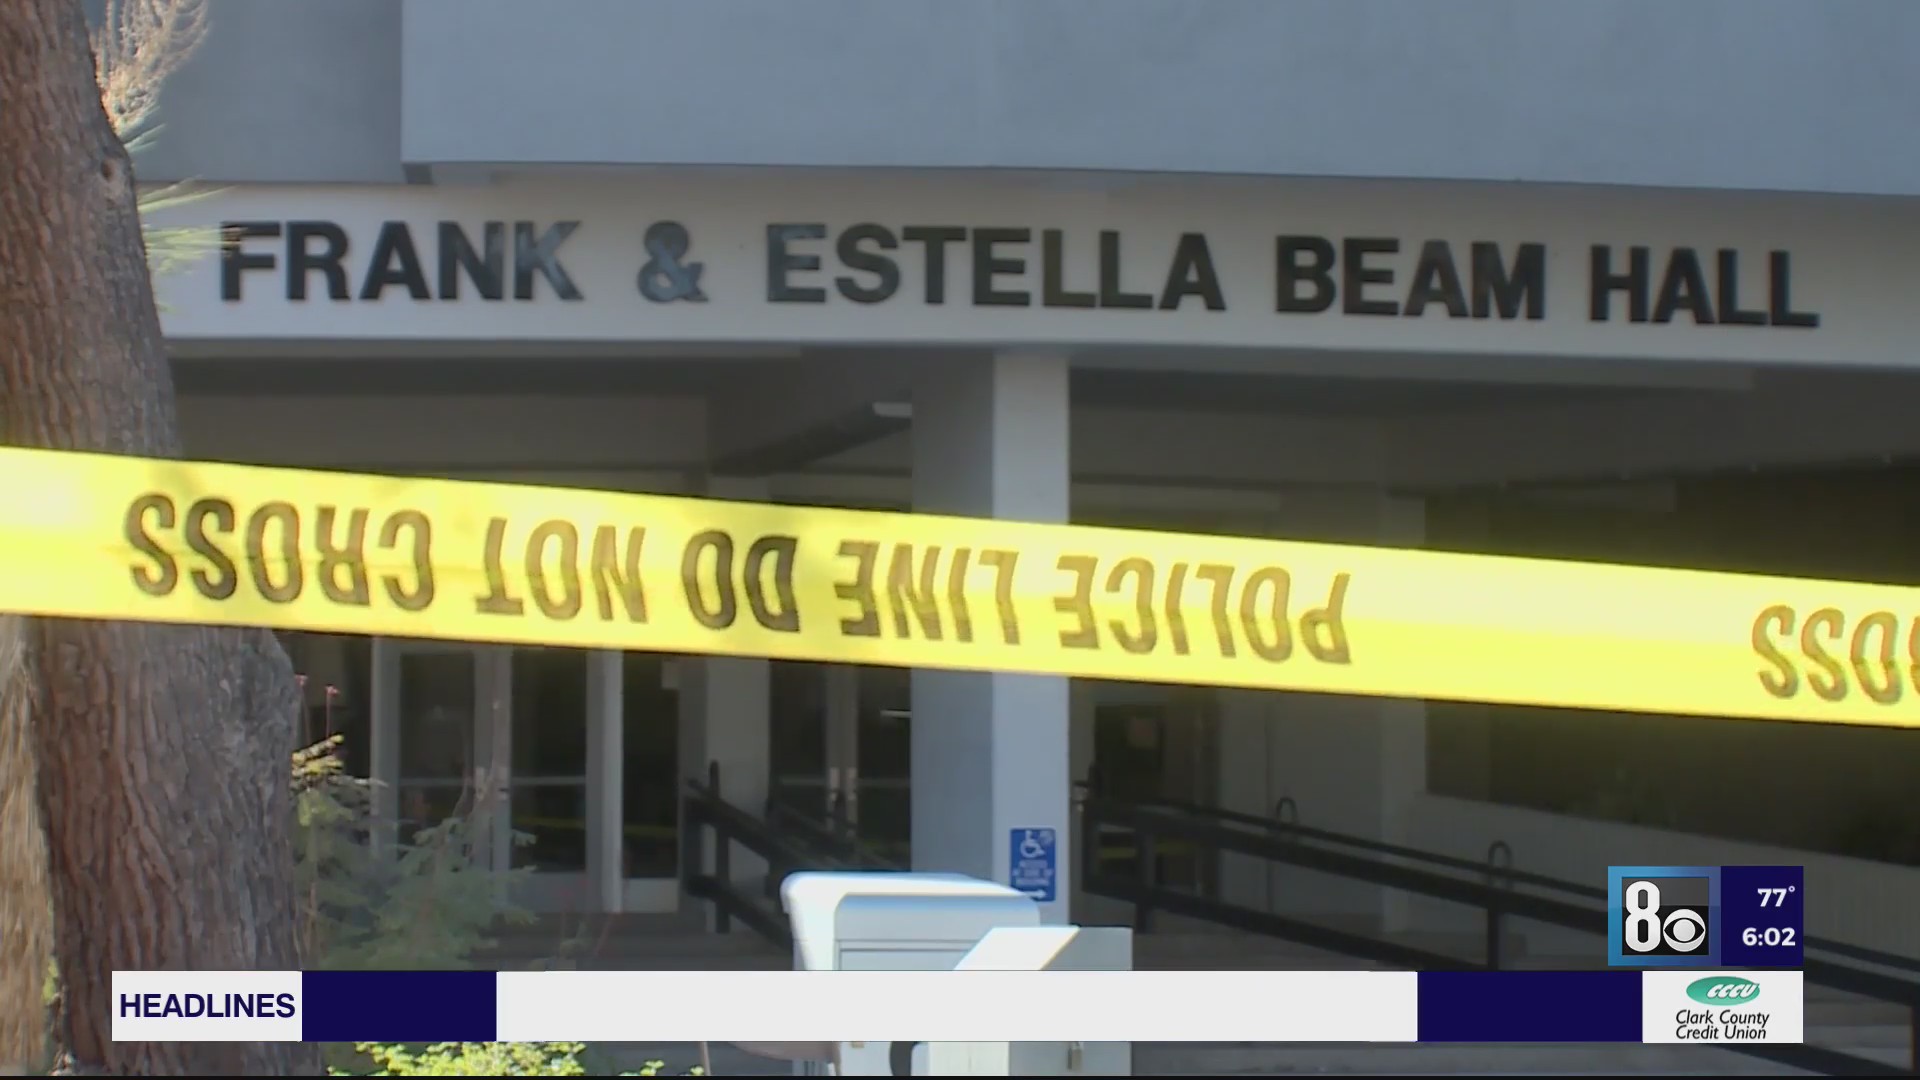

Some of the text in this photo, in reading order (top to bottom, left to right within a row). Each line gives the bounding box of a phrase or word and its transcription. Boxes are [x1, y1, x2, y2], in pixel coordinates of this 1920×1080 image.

[219, 220, 1820, 328] FRANK & ESTELLA BEAM HALL
[124, 493, 1351, 665] POLICE LINE DO NOT CROSS
[1752, 604, 1920, 706] OSS
